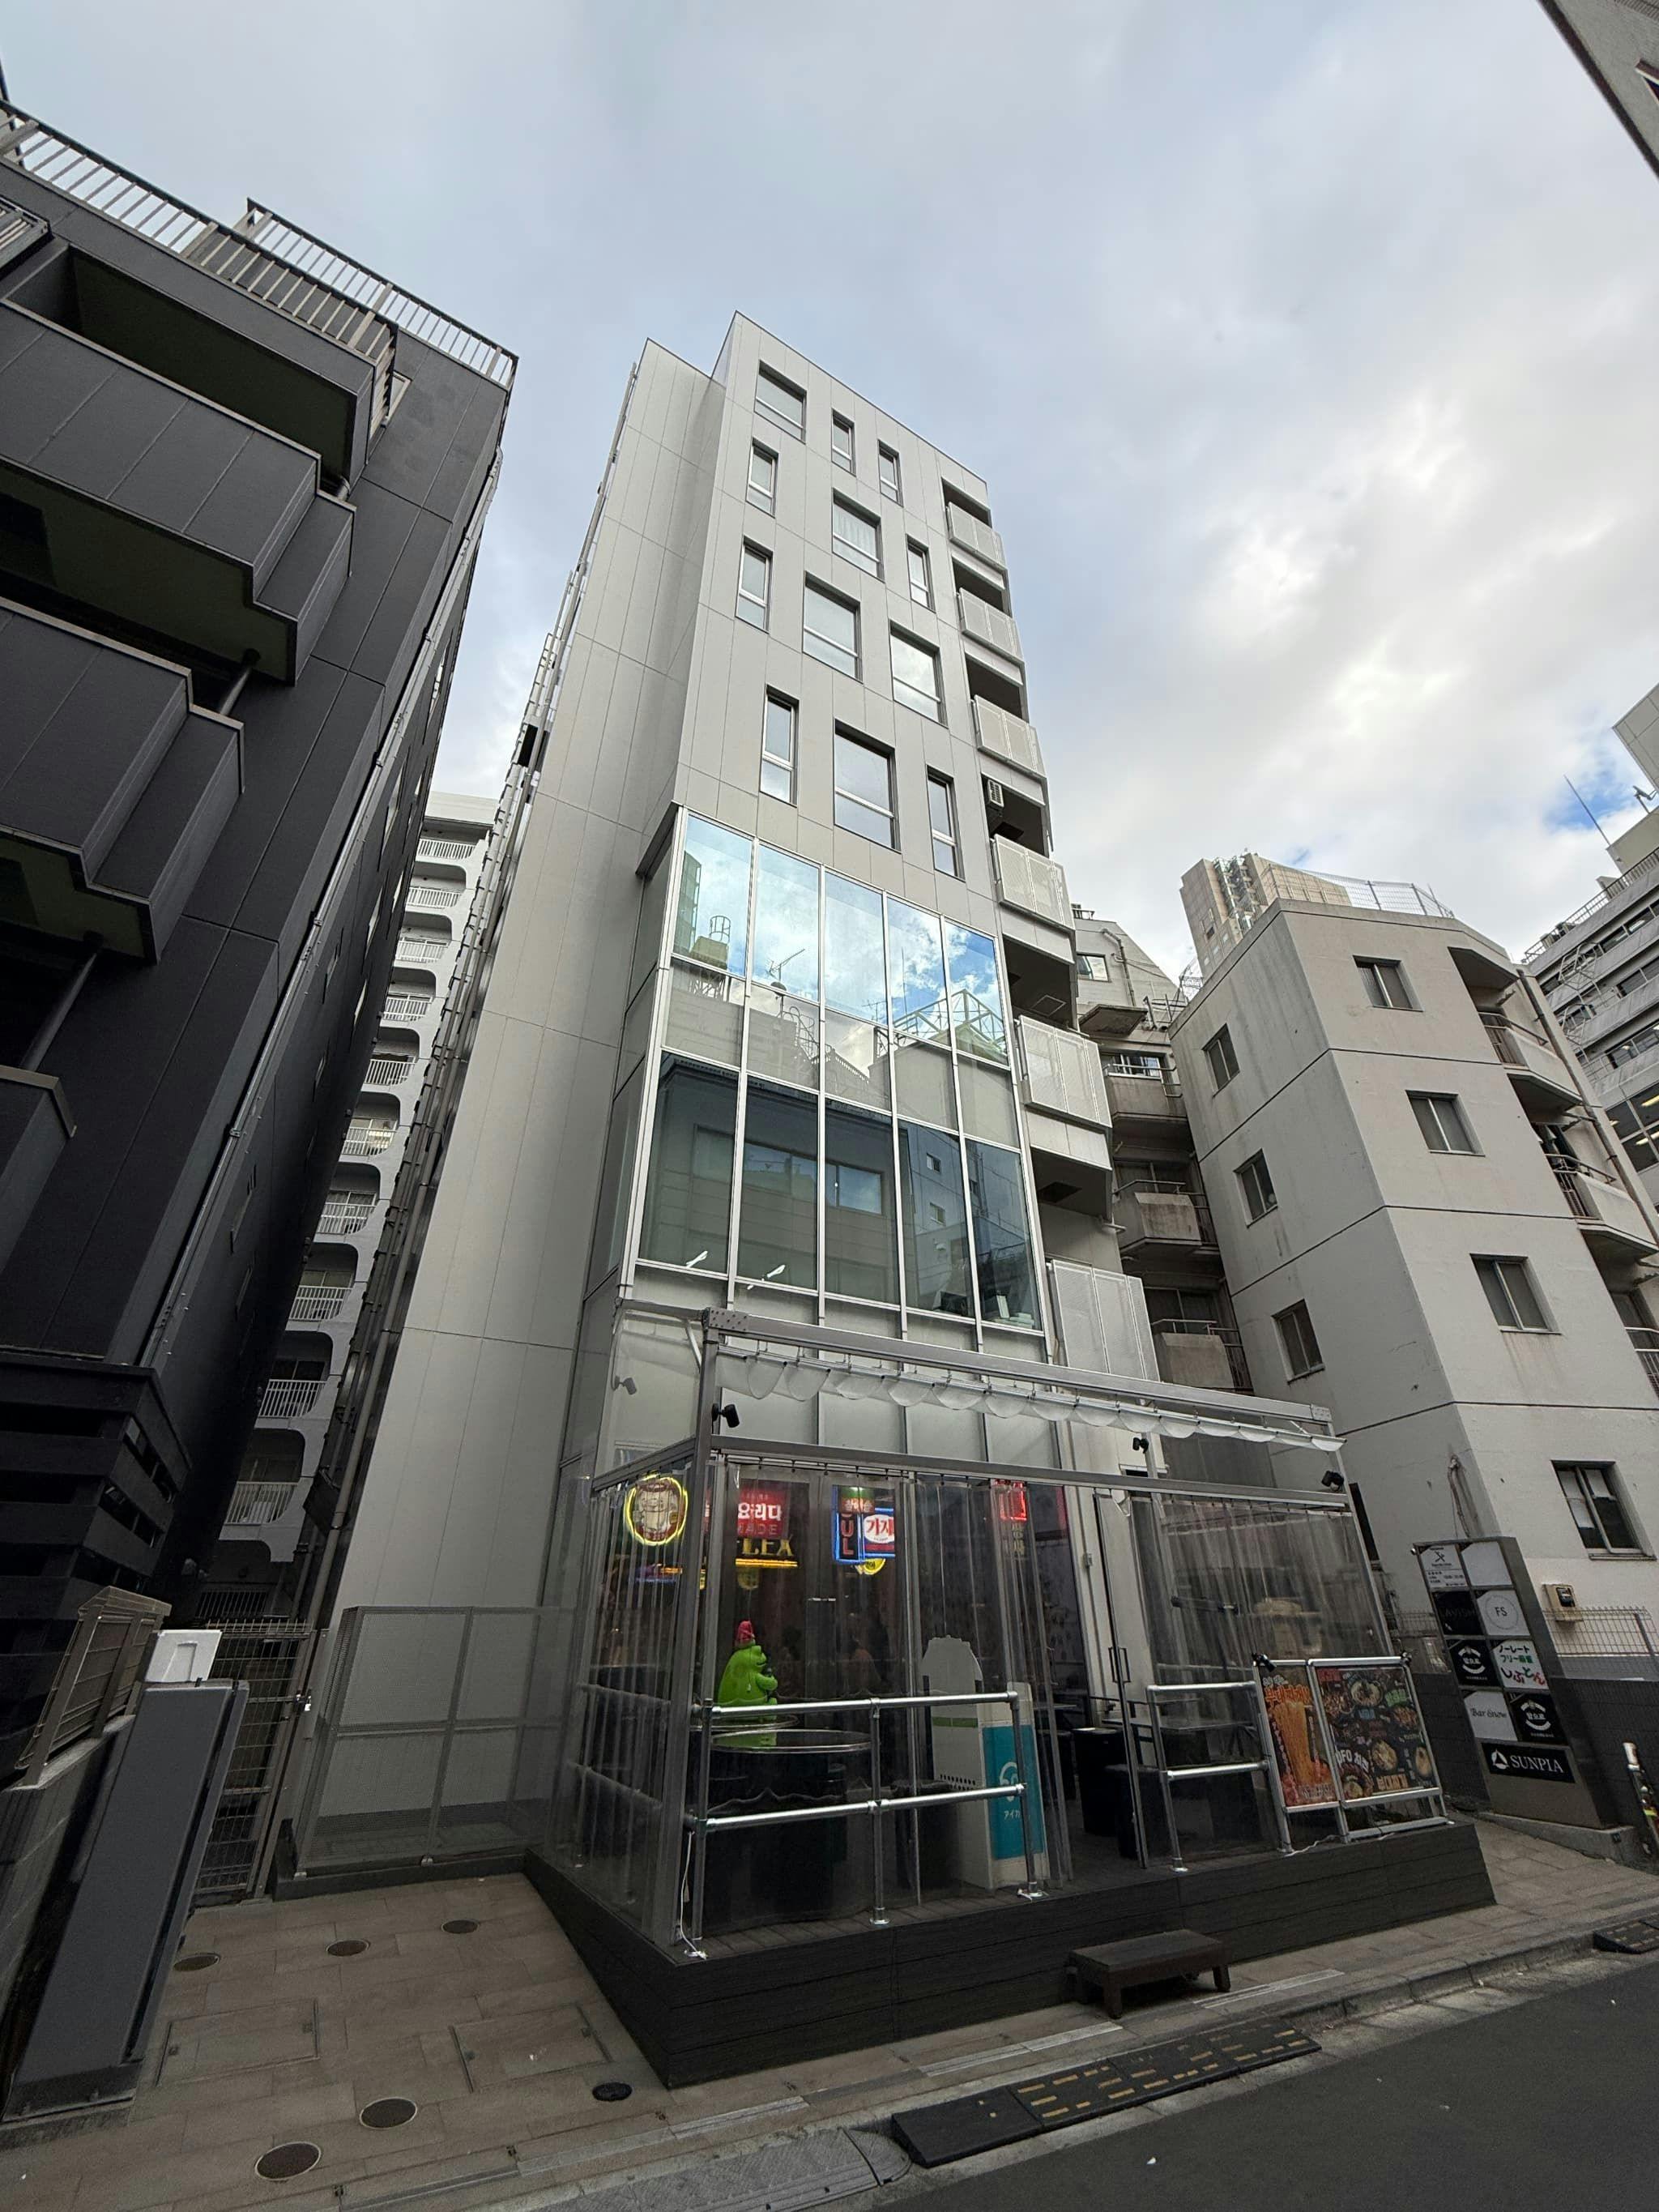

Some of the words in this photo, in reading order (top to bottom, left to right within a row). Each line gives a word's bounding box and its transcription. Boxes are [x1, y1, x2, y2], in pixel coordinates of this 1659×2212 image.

[1495, 1607, 1508, 1616] FS
[1499, 1645, 1529, 1654] ノーレート
[1470, 1708, 1486, 1717] Bar
[1510, 1756, 1563, 1774] SUNPIA
